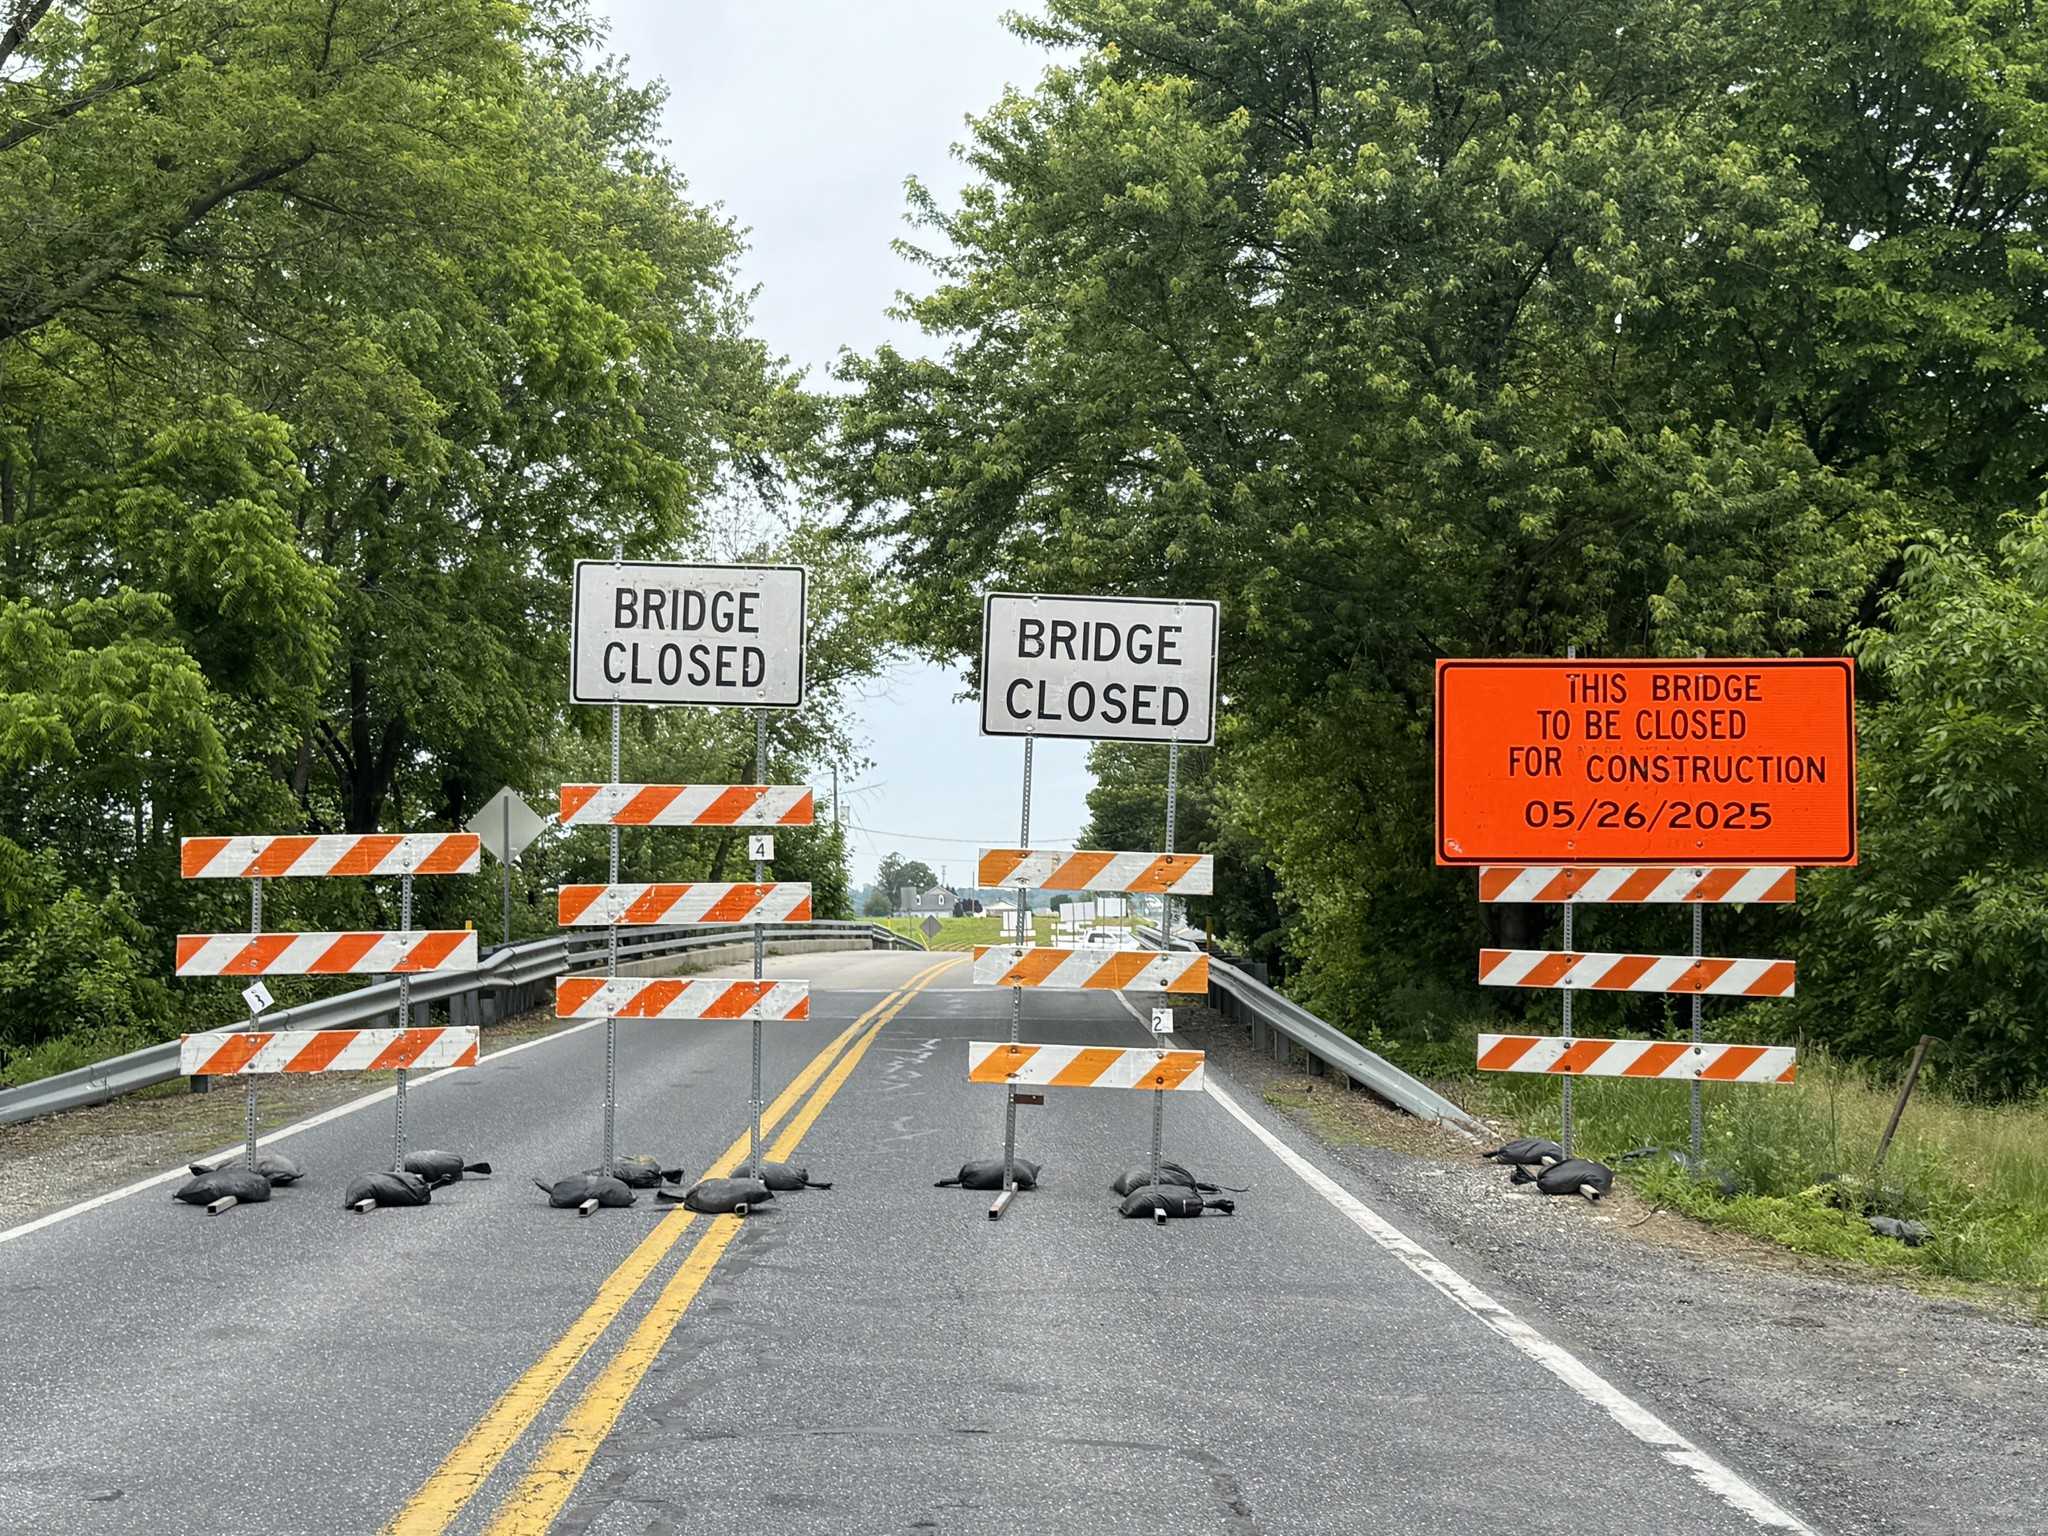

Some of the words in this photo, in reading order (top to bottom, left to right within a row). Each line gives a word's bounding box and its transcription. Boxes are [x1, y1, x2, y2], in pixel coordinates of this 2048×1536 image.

[614, 587, 761, 634] BRIDGE
[1017, 618, 1183, 666] BRIDGE
[603, 641, 766, 688] CLOSED
[1006, 678, 1190, 727] CLOSED
[1565, 672, 1627, 704] THIS
[1652, 674, 1763, 702] BRIDGE
[1536, 709, 1571, 741] TO
[1585, 709, 1621, 740] BE
[1635, 708, 1746, 740] CLOSED
[1508, 746, 1562, 777] FOR
[1586, 754, 1826, 783] CONSTRUCTION
[1524, 797, 1773, 833] 05/26/2025
[755, 842, 765, 858] 4
[1153, 1015, 1162, 1032] 2
